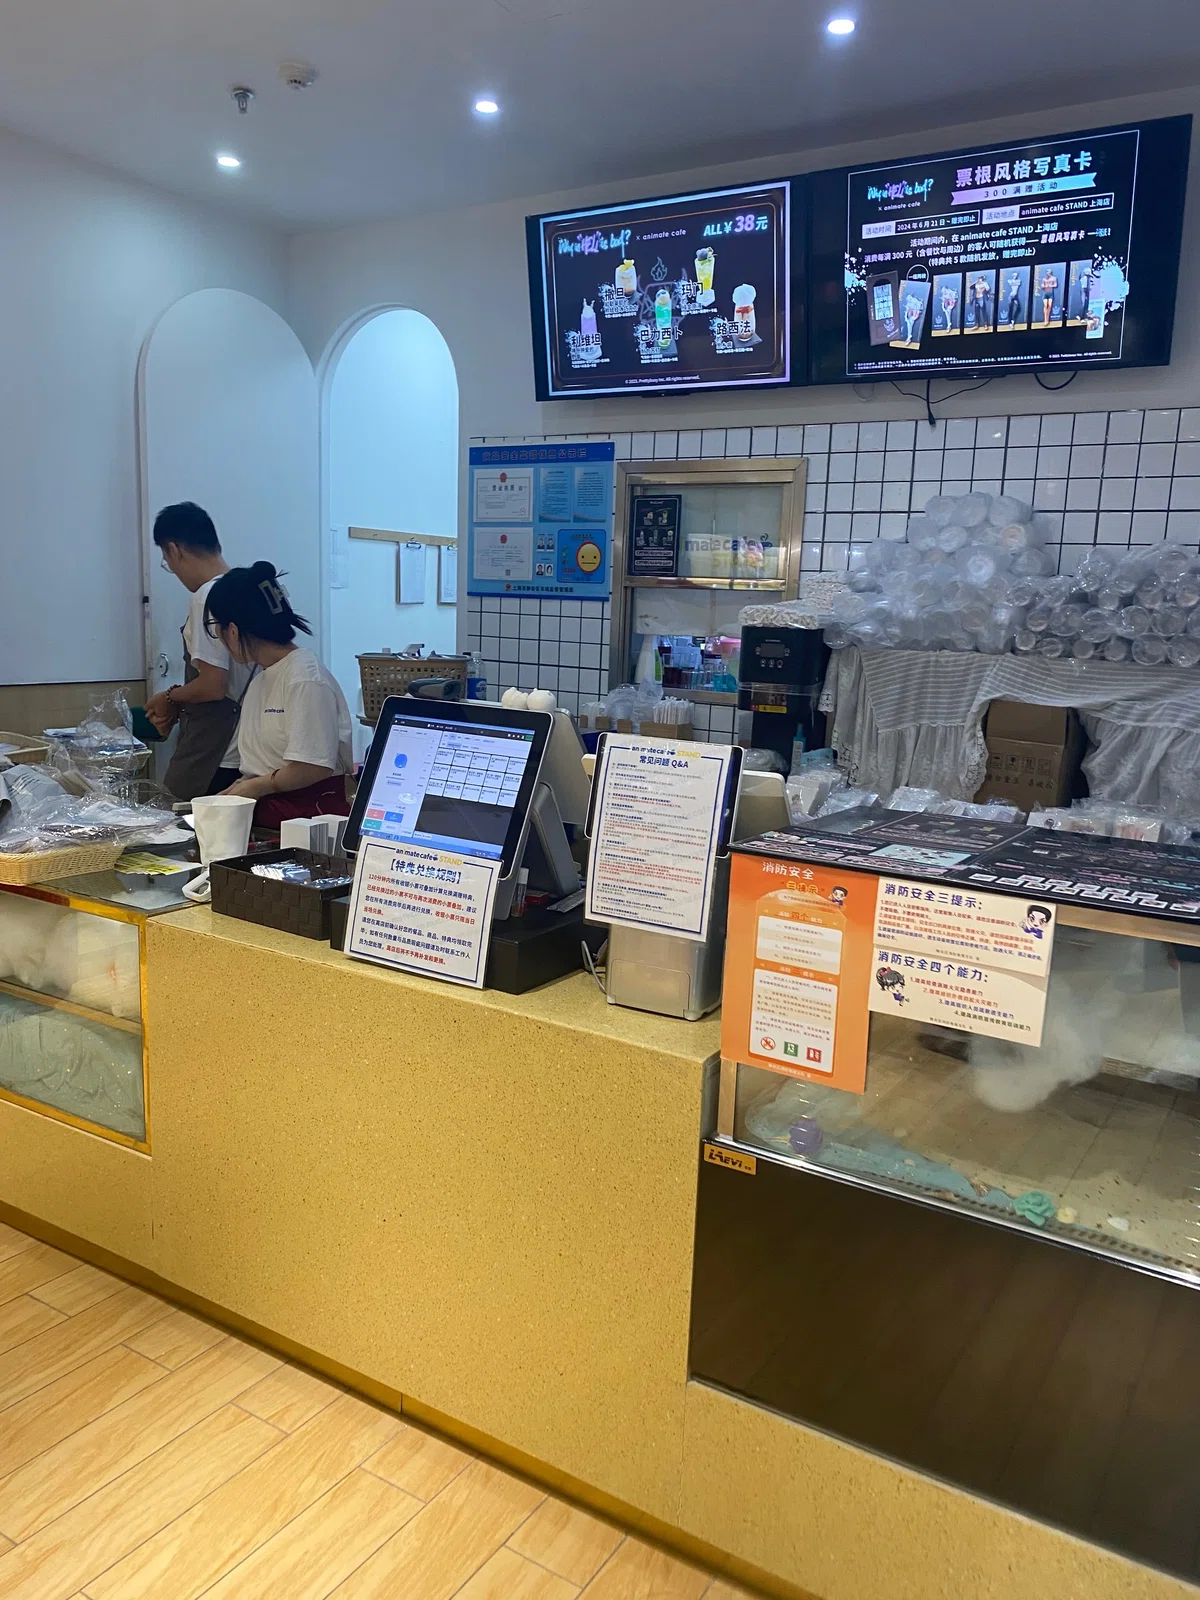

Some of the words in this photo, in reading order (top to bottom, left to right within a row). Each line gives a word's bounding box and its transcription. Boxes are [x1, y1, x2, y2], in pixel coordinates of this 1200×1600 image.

[956, 151, 1092, 187] 票根风格写真卡
[884, 203, 906, 211] animate
[986, 211, 1015, 220] 活动地点
[1021, 206, 1049, 216] animate
[1050, 203, 1064, 212] cafe
[1065, 200, 1088, 210] STAND
[1089, 198, 1110, 207] 上海店
[643, 230, 669, 240] animate
[671, 228, 686, 237] cafe
[866, 225, 892, 235] 活动时间
[897, 223, 911, 231] 2024
[912, 222, 918, 230] 年
[960, 231, 990, 241] animate
[991, 228, 1007, 237] cafe
[1008, 225, 1034, 235] STAND
[1035, 222, 1058, 232] 上海店
[864, 252, 891, 263] 消费每满
[892, 251, 905, 259] 300
[953, 256, 958, 264] 5
[682, 281, 703, 296] 玛门
[641, 327, 683, 342] 巴力西卜
[717, 320, 751, 335] 路西法
[571, 333, 602, 346] 利维坦
[639, 755, 670, 766] 常见问题
[671, 760, 689, 768] Q&A
[677, 750, 700, 758] STAND
[396, 848, 433, 861] anmatecafe
[439, 855, 462, 866] STAND
[762, 861, 815, 881] 消防安全
[786, 881, 818, 895] 三提示
[885, 883, 982, 910] 消防安全三提示：
[878, 951, 988, 983] 消防安全四个能力：
